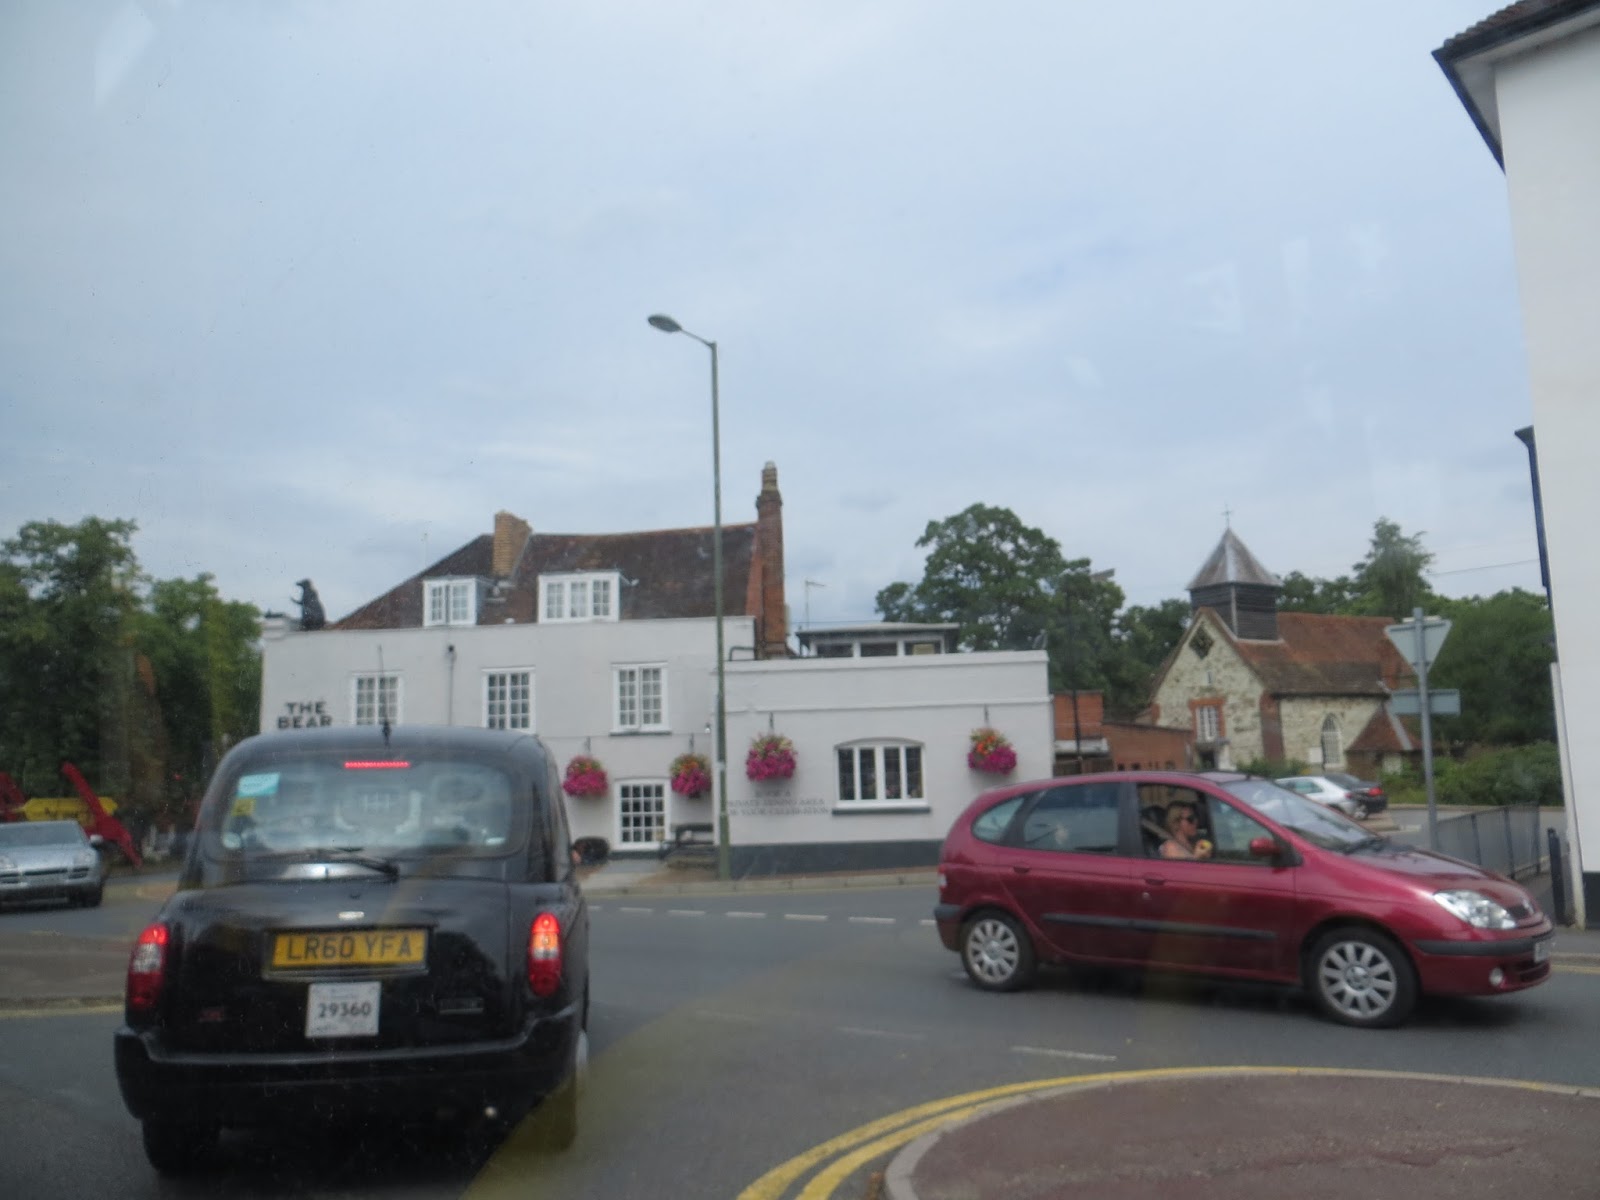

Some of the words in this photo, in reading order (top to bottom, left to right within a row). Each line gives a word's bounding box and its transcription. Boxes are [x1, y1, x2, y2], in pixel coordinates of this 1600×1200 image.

[285, 701, 326, 714] THE
[277, 715, 332, 729] BEAR
[286, 934, 355, 961] LR60
[364, 933, 413, 958] YFA
[318, 1000, 372, 1019] 29360
